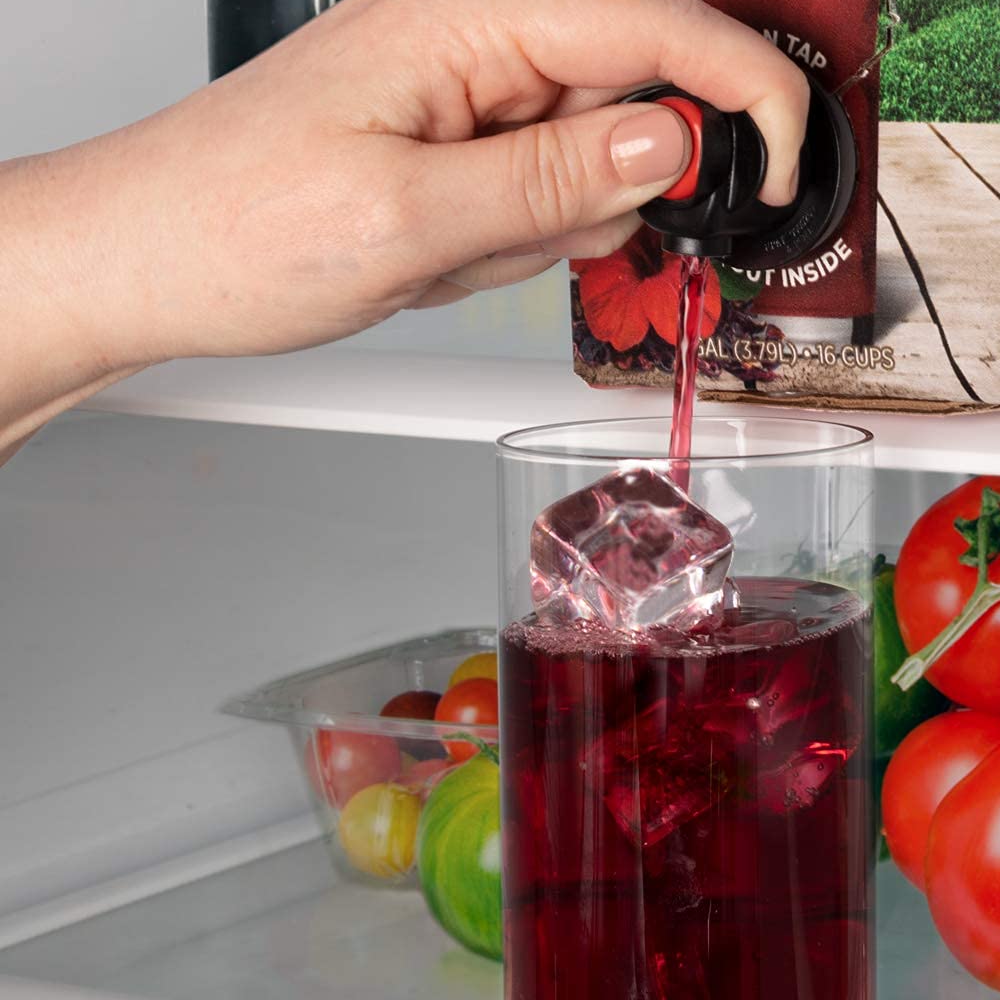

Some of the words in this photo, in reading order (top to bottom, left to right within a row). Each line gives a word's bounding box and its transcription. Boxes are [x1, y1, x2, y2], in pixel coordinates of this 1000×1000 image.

[763, 28, 779, 48] N
[786, 33, 828, 69] TAP
[781, 238, 853, 288] INSIDE
[734, 339, 797, 367] (3.79L)
[816, 344, 836, 366] 16
[841, 346, 895, 370] CUPS
